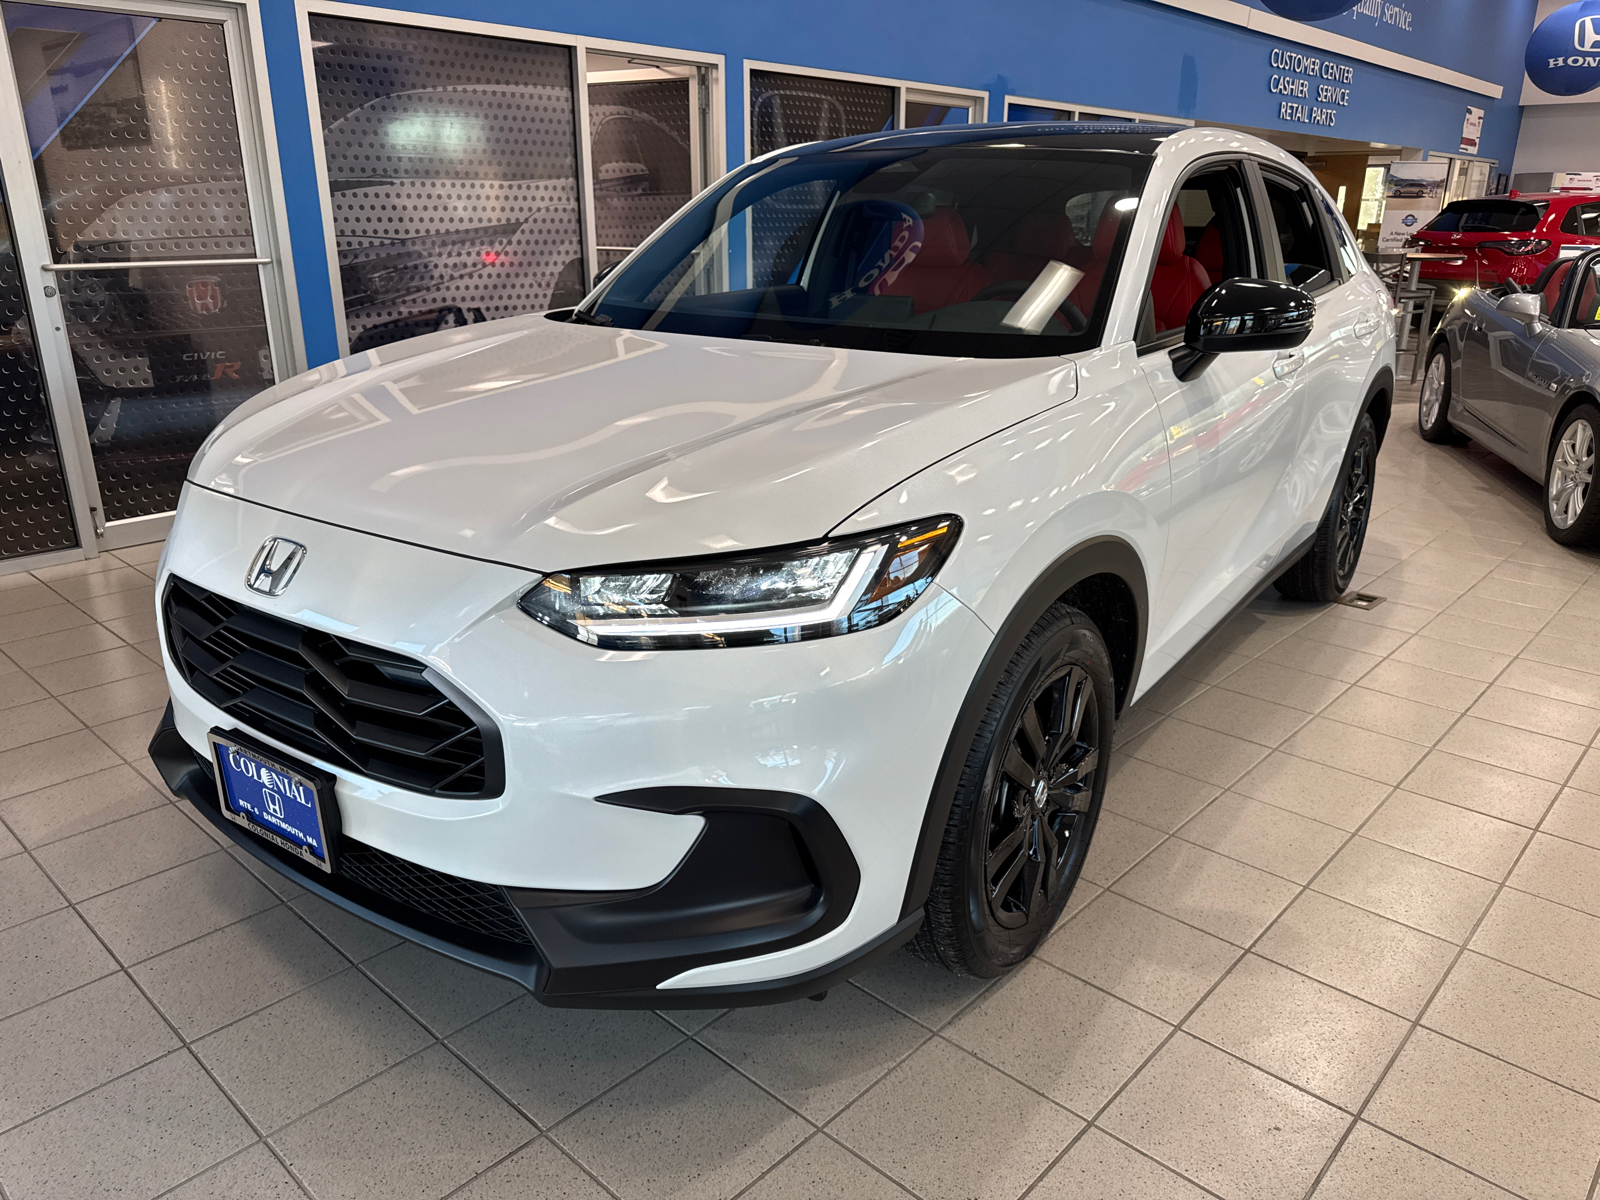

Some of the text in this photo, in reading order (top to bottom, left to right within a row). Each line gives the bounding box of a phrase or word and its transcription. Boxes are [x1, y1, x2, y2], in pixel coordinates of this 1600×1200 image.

[1383, 2, 1412, 32] service.
[1271, 48, 1354, 84] CUSTOMER CENTER
[1547, 56, 1600, 69] HON
[1270, 74, 1350, 106] CASHIER SERVICE
[1280, 101, 1337, 127] RETAIL PARTS
[183, 351, 226, 361] CIVIC
[247, 822, 304, 858] COLONIAL HONDA
[306, 835, 319, 848] MA
